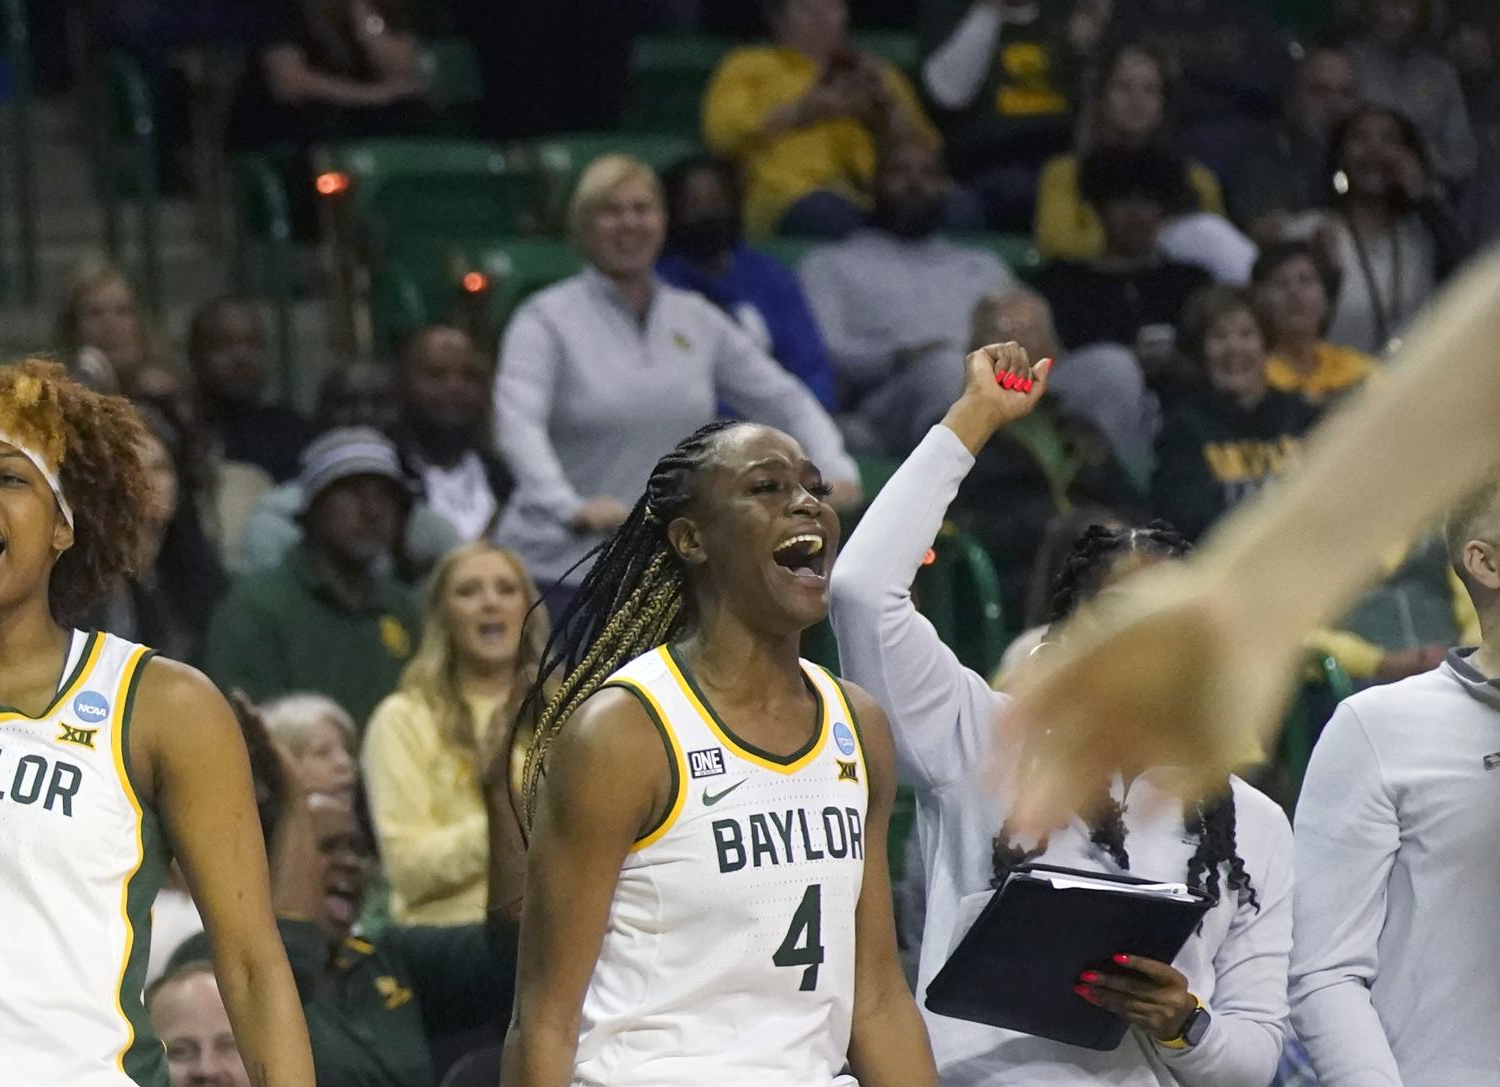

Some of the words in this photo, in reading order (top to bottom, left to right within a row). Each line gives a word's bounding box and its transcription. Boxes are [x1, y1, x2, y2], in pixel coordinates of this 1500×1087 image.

[78, 703, 107, 717] NCAA
[691, 750, 724, 771] ONE
[711, 806, 864, 874] BAYLOR
[772, 883, 825, 992] 4
